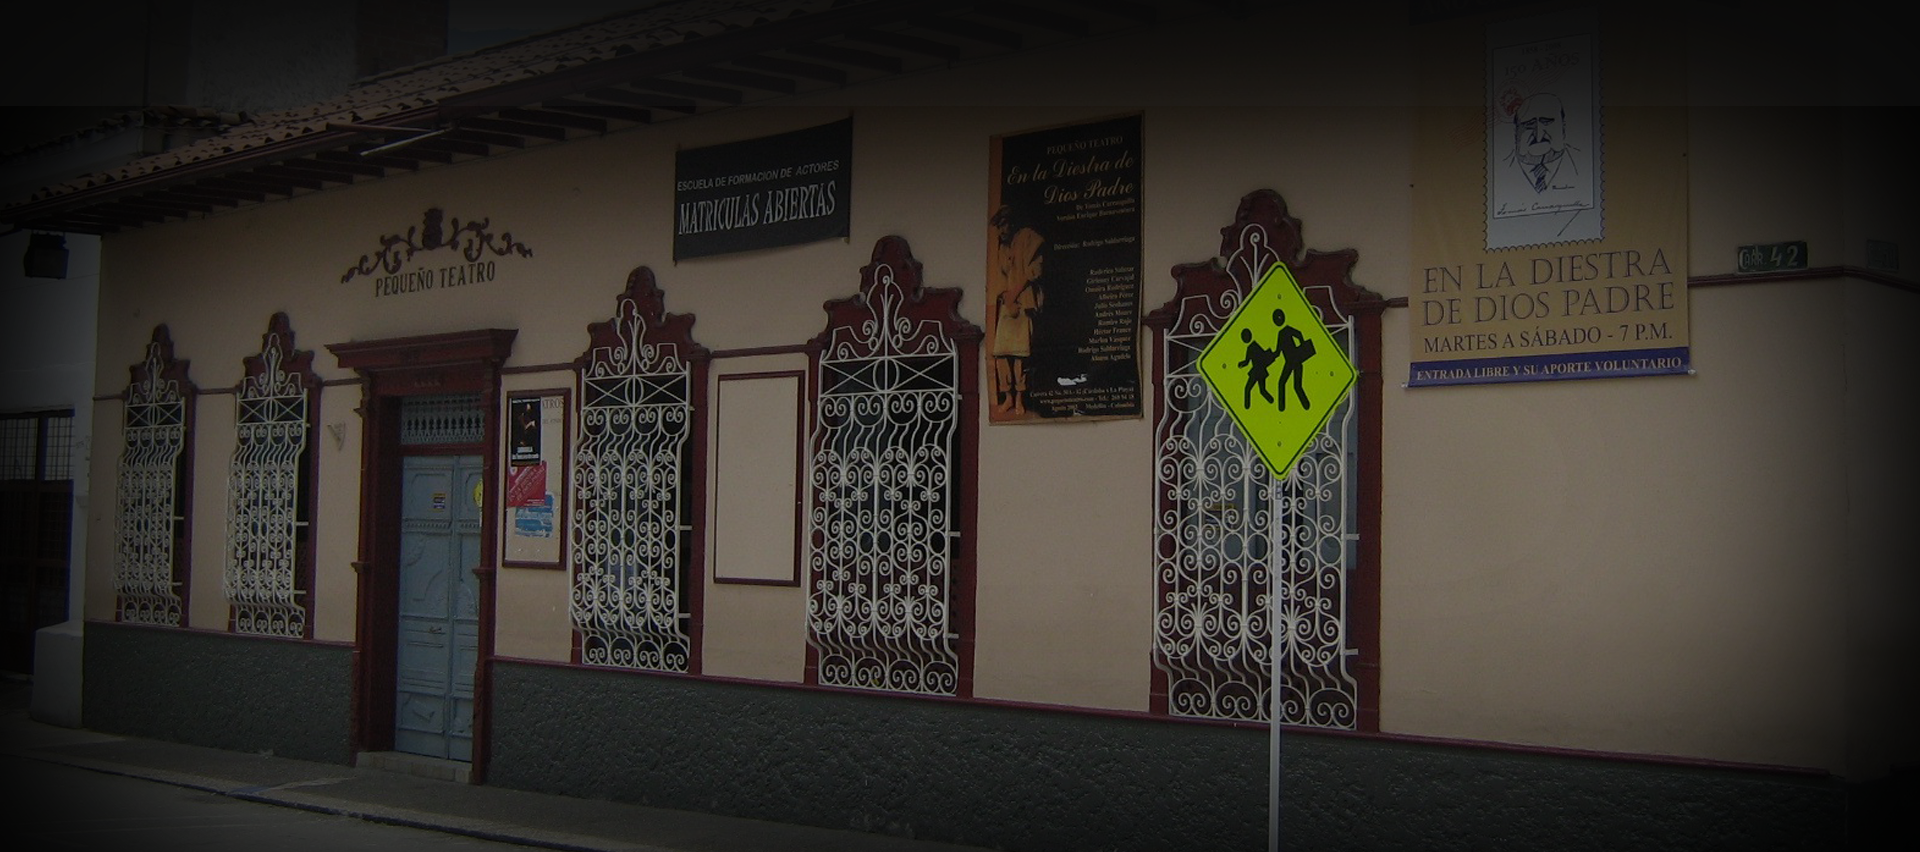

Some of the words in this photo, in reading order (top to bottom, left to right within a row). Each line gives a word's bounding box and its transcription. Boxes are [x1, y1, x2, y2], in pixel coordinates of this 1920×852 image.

[1505, 64, 1527, 80] 150
[1532, 52, 1580, 72] AÑOS
[1047, 140, 1086, 155] PEQUEÑO
[1090, 136, 1124, 148] TEATRO
[677, 178, 714, 191] ESCUELA
[715, 176, 727, 187] DE
[727, 169, 779, 186] FORMACION
[780, 167, 792, 177] DE
[795, 160, 840, 176] ACTORES
[1006, 166, 1029, 185] En
[1033, 163, 1048, 182] la
[1053, 155, 1110, 178] Diestra
[1114, 150, 1134, 169] de
[1044, 185, 1078, 205] Dios
[1084, 176, 1133, 199] Padre
[678, 192, 760, 235] MATRICULAS
[762, 180, 837, 225] ABIERTAS
[376, 267, 433, 297] PEQUEÑO
[440, 261, 495, 288] TEATRO
[1423, 264, 1463, 294] EN
[1476, 261, 1517, 290] LA
[1529, 248, 1673, 286] DIESTRA
[1421, 298, 1462, 327] DE
[1474, 291, 1550, 324] DIOS
[1561, 281, 1675, 317] PADRE
[1424, 333, 1498, 354] MARTES
[1502, 333, 1515, 348] A
[1520, 326, 1601, 348] SÁBADO
[1620, 324, 1629, 342] 7
[1635, 322, 1673, 341] P.M.
[1417, 368, 1472, 381] ENTRADA
[1474, 365, 1510, 378] LIBRE
[1513, 365, 1521, 377] Y
[1523, 364, 1540, 376] SU
[1541, 361, 1592, 376] APORTE
[1595, 356, 1682, 372] VOLUNTARIO
